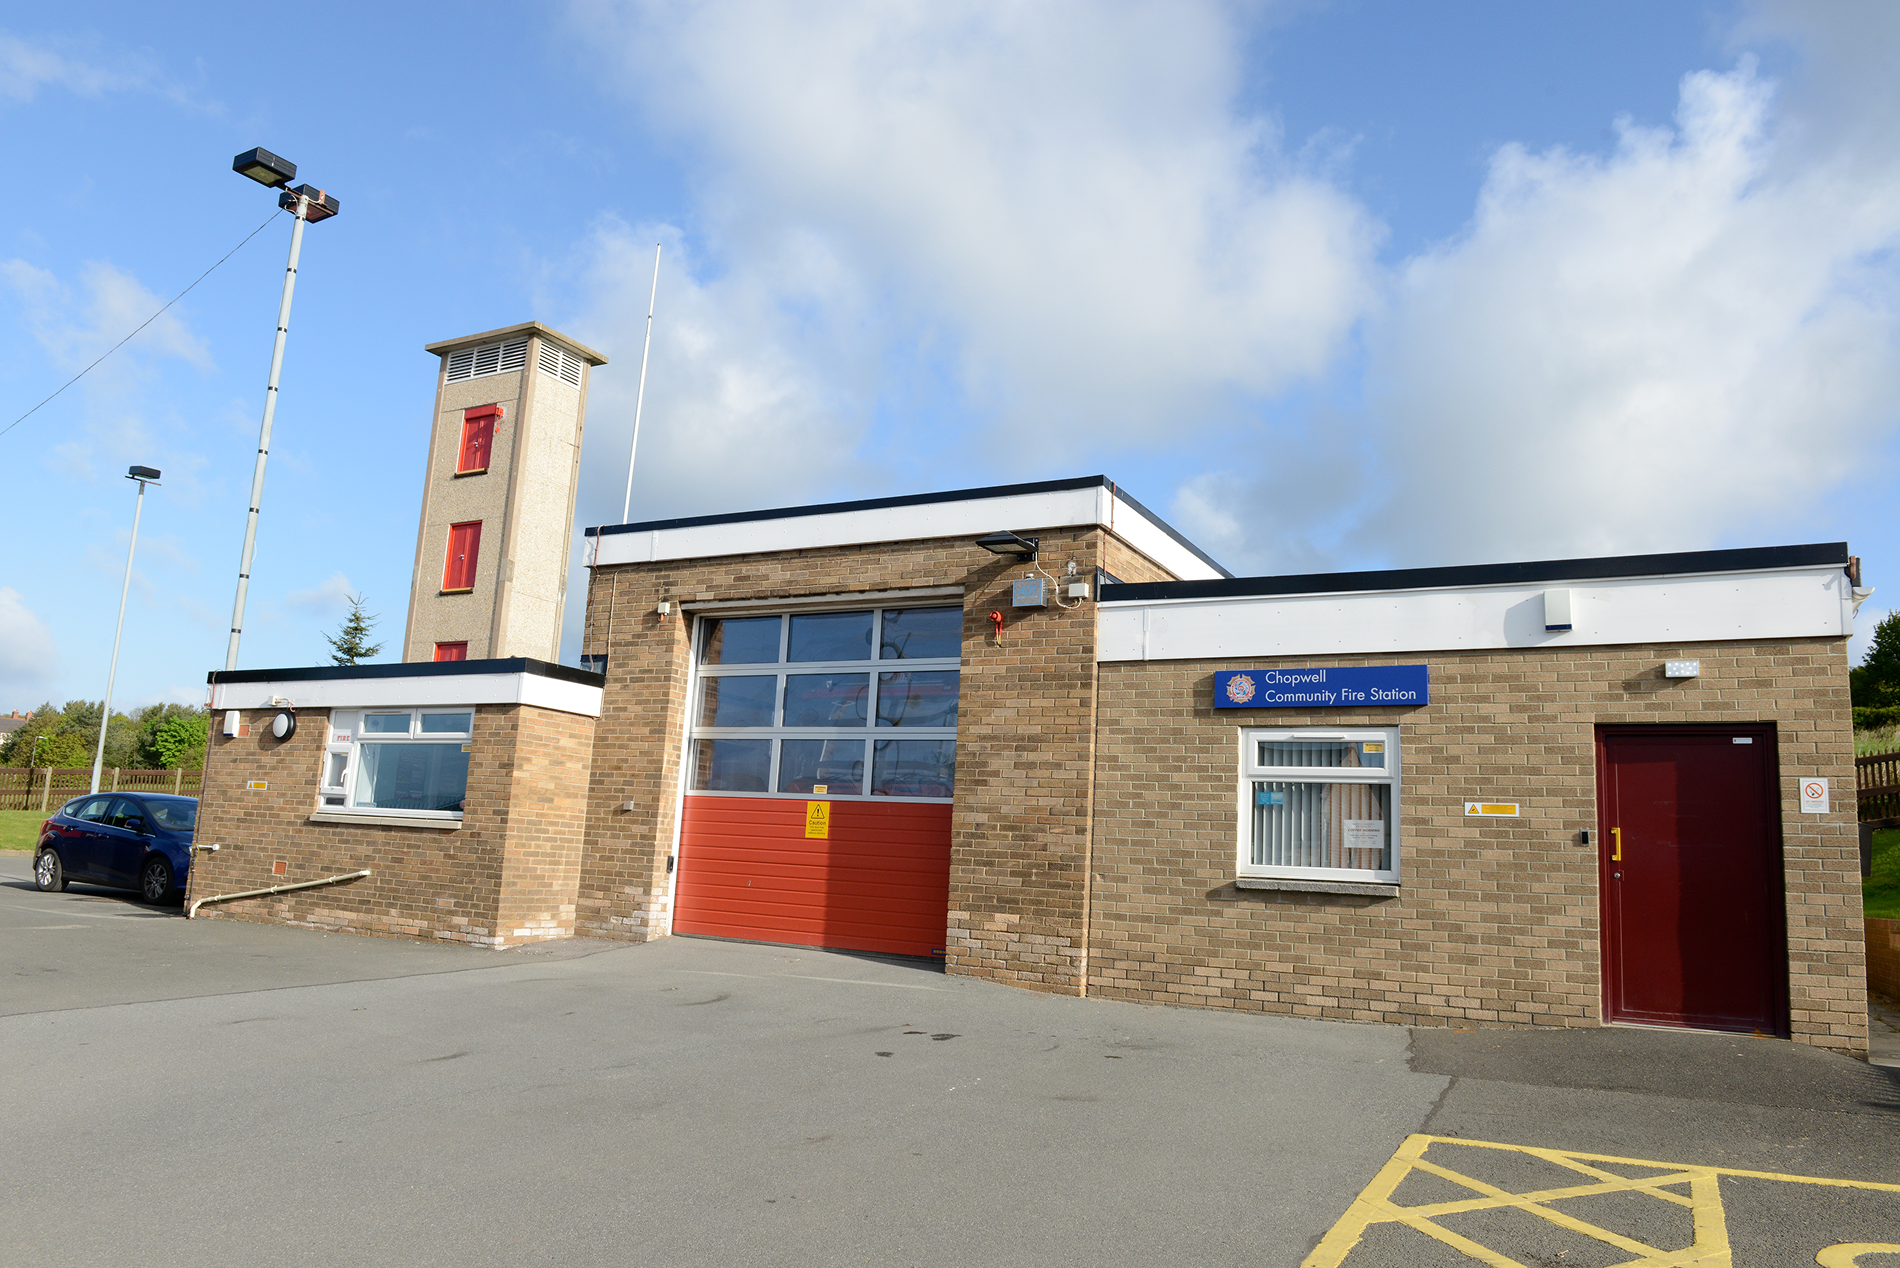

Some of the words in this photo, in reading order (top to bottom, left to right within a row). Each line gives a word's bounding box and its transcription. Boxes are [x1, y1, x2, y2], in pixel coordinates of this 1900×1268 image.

[1017, 584, 1038, 596] ADT
[1265, 669, 1326, 687] Chopwell
[1265, 690, 1337, 705] Community
[1341, 688, 1365, 701] Fire
[1370, 687, 1417, 701] Station
